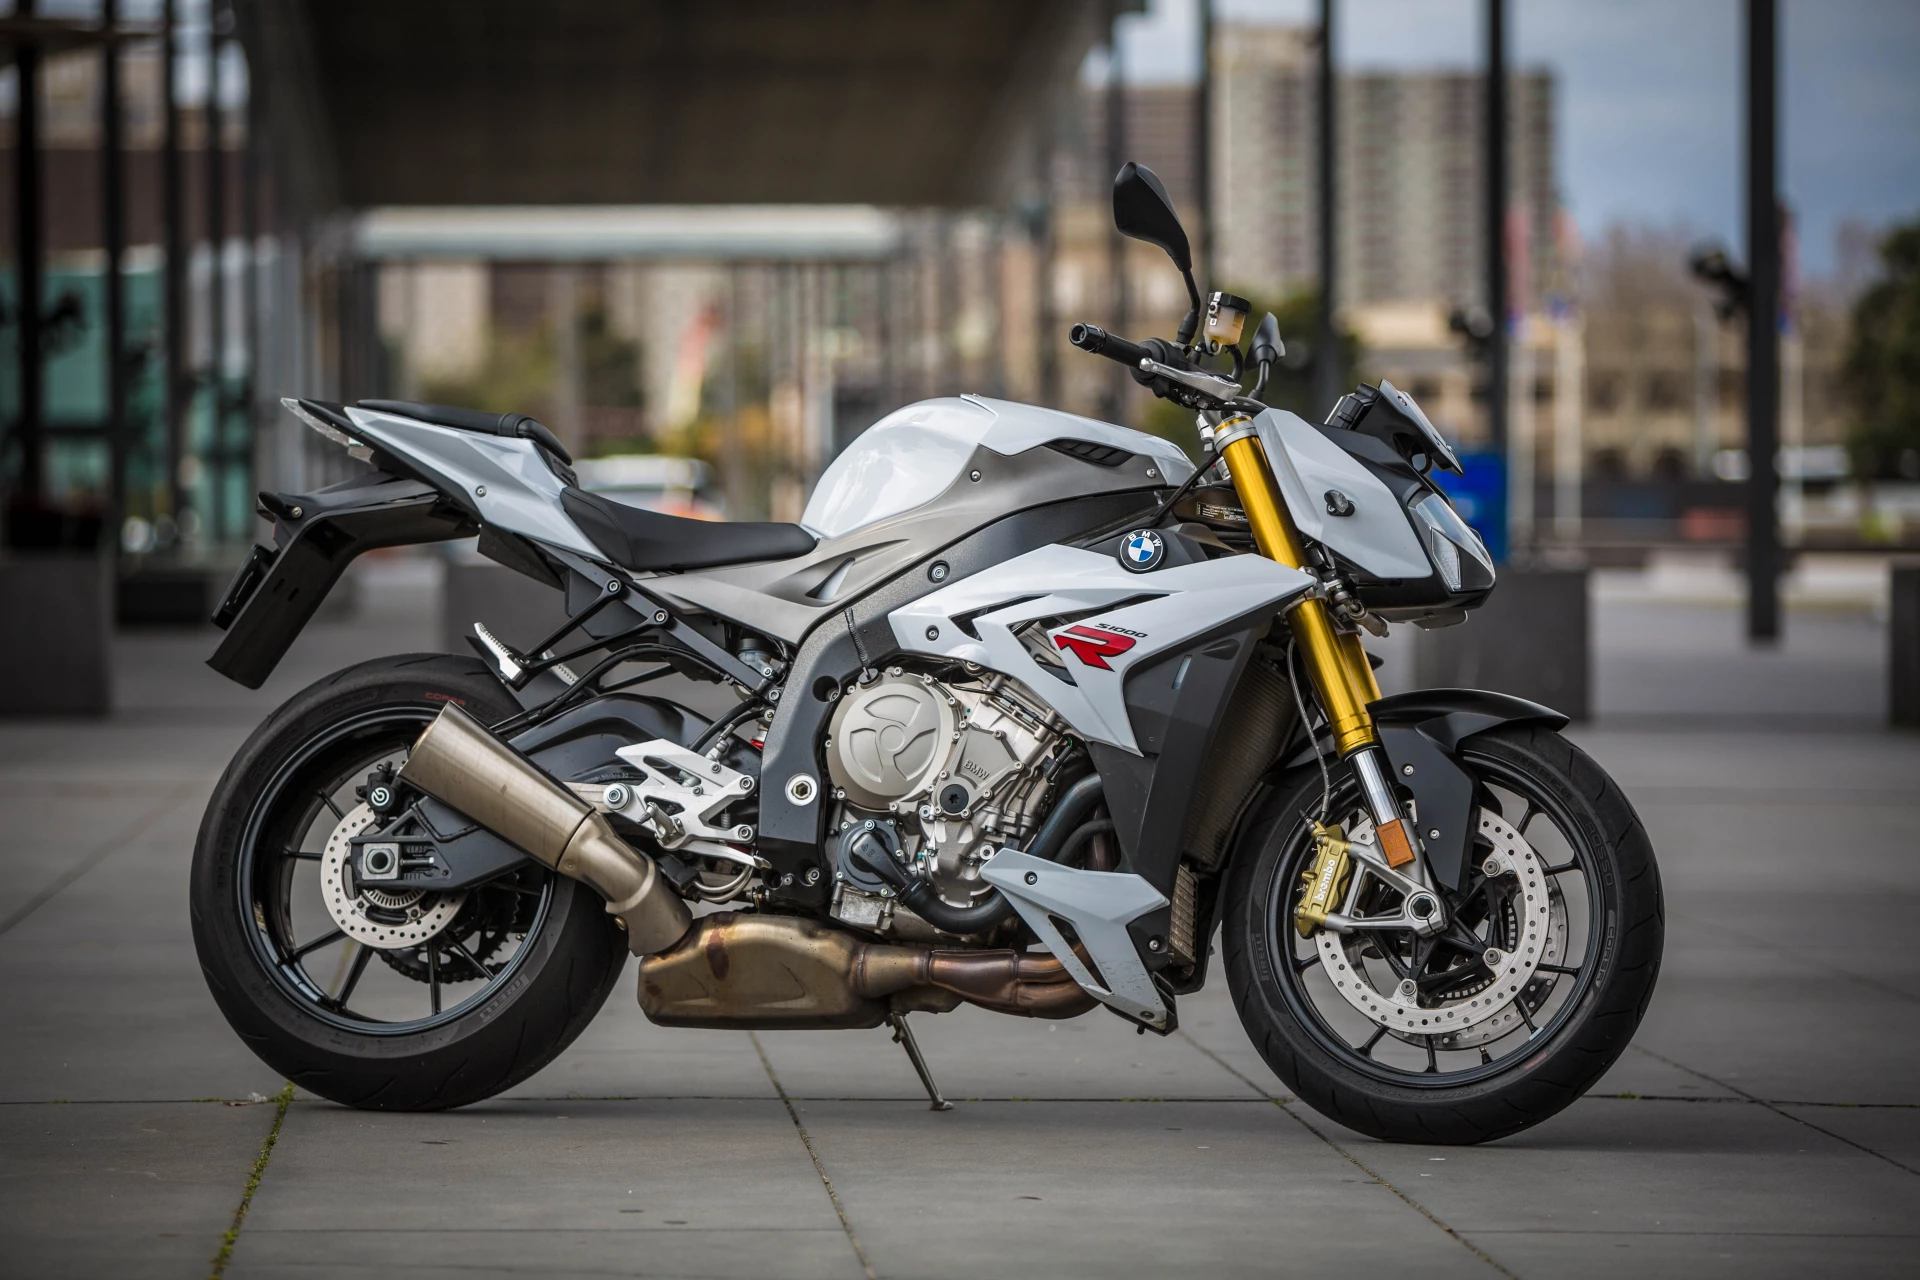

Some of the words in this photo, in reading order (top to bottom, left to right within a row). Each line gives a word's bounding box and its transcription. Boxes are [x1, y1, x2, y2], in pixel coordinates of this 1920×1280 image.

[1128, 530, 1162, 547] BMW
[1053, 624, 1137, 673] R
[1095, 623, 1148, 638] S1000
[321, 690, 373, 715] CORSA
[248, 726, 301, 782] ROSSO
[964, 759, 990, 780] BMW
[1584, 821, 1613, 886] ROSSO
[1314, 859, 1336, 901] brembo
[1250, 932, 1270, 982] PIRELLI
[1595, 926, 1615, 983] CORSA
[479, 973, 530, 1022] PIRELLI
